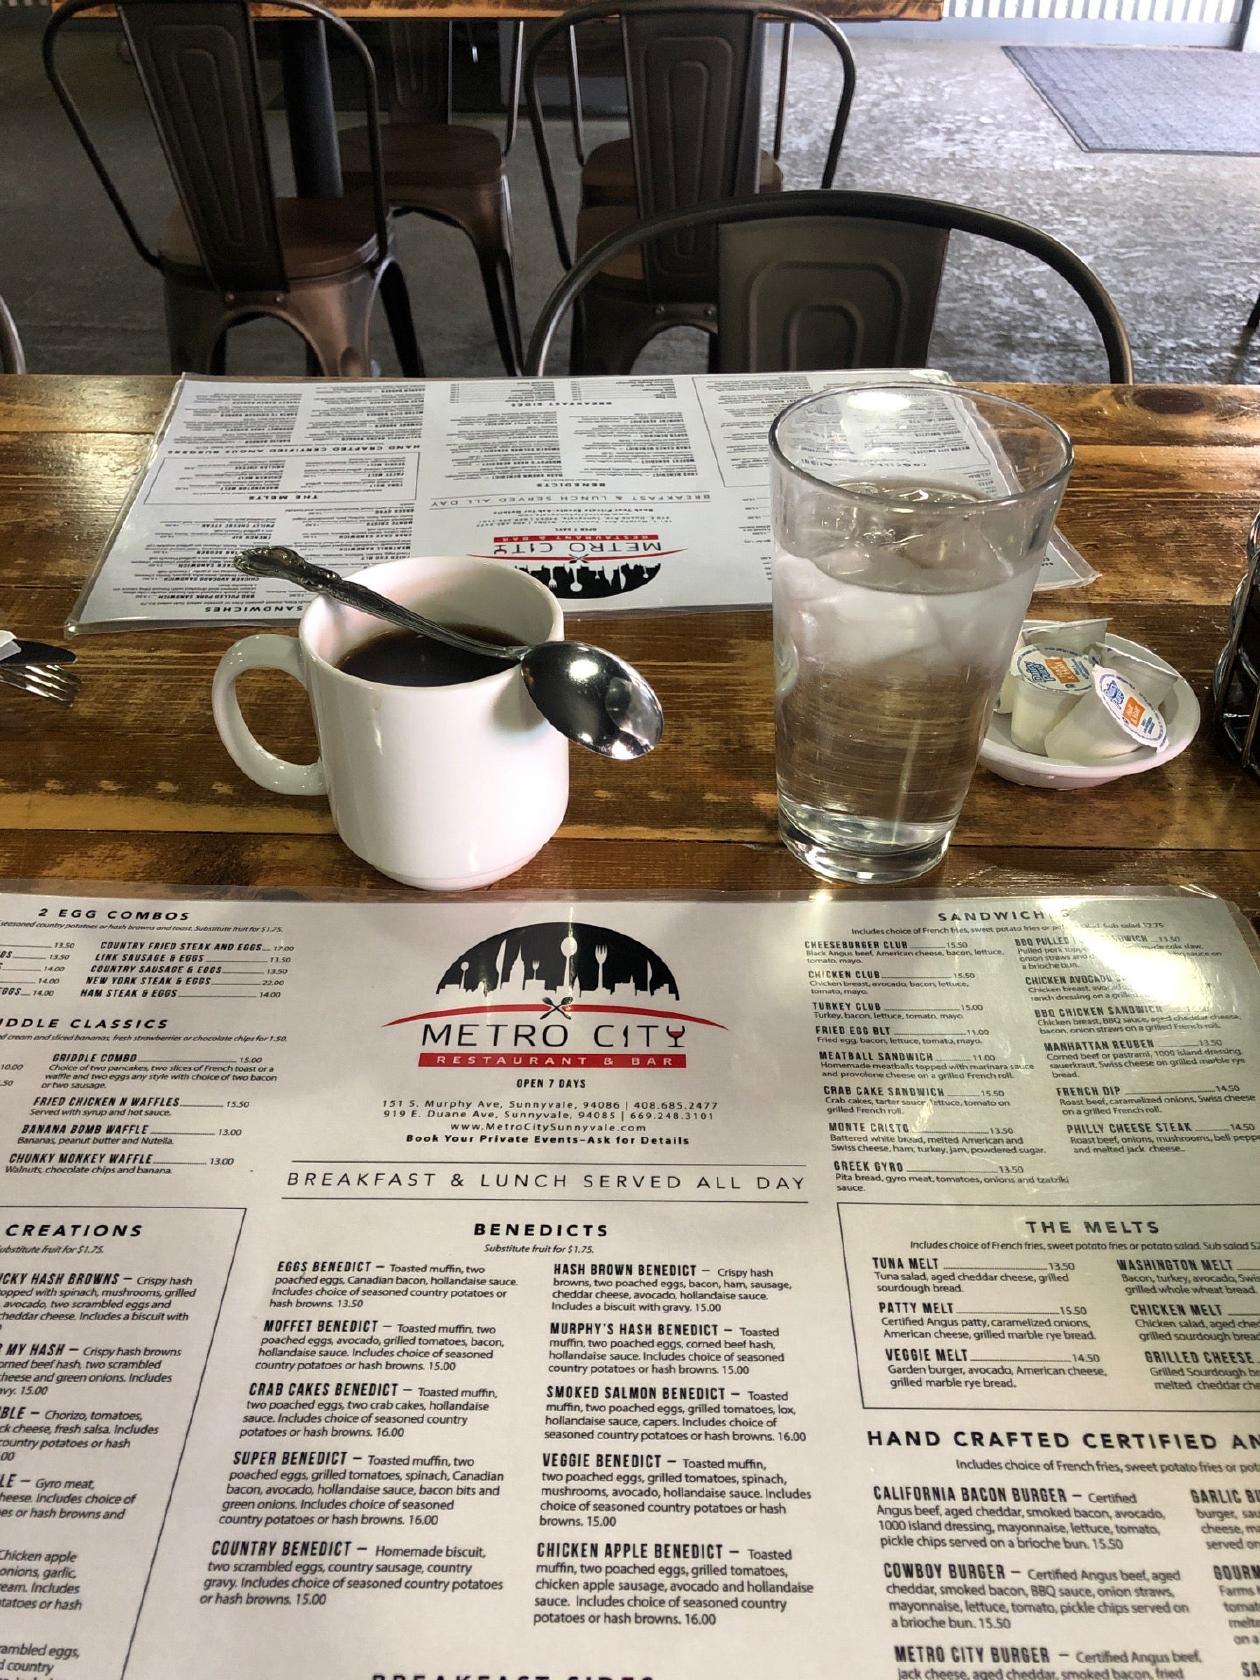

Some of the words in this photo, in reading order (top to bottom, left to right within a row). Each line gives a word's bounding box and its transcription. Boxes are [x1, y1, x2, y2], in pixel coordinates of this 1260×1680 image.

[494, 543, 552, 554] CITY
[570, 542, 661, 552] METRO
[39, 908, 48, 916] 2
[59, 909, 96, 918] EGG
[108, 911, 188, 920] COMBOS
[805, 941, 879, 949] CHEESEBURGER
[81, 989, 102, 997] HAM
[813, 1002, 850, 1010] TURKEY
[856, 1003, 880, 1011] CLUB
[71, 1019, 167, 1028] CLASSICS
[422, 1024, 568, 1047] METRO
[594, 1025, 685, 1047] CITY
[816, 1026, 845, 1034] FRIED
[850, 1026, 868, 1035] EGG
[873, 1027, 889, 1035] BLT
[1044, 1041, 1109, 1051] MANHATTAN
[1112, 1040, 1154, 1049] REUBEN
[53, 1054, 96, 1062] GRIDDLE
[101, 1054, 137, 1062] COMBO
[437, 1056, 586, 1064] RESTAURANT
[517, 1079, 543, 1087] OPEN
[549, 1079, 554, 1088] 7
[559, 1079, 585, 1088] DAYS
[1056, 1087, 1099, 1096] FRENCH
[1103, 1086, 1120, 1095] DIP
[33, 1097, 65, 1106] FRIED
[69, 1097, 116, 1106] CHICKEN
[119, 1098, 127, 1106] N
[131, 1097, 180, 1106] WAFFLES
[425, 1100, 472, 1109] Murphy
[509, 1101, 577, 1110] Sunnyvale,
[505, 1111, 571, 1120] Sunnyvale,
[631, 1112, 712, 1120] 669.248.3101
[22, 1125, 66, 1133] BANANA
[70, 1125, 101, 1134] BOMB
[106, 1125, 148, 1134] WAFFLE
[451, 1123, 646, 1132] www.MetroCitySunnyvale.com
[480, 1135, 528, 1143] Private
[616, 1136, 634, 1144] for
[10, 1153, 55, 1163] CHUNKY
[59, 1154, 105, 1163] MONKEY
[109, 1154, 152, 1164] WAFFLE
[834, 1161, 869, 1171] GREEK
[874, 1162, 903, 1172] GYRO
[288, 1173, 435, 1186] BREAKFAST
[451, 1174, 463, 1186] &
[481, 1174, 565, 1187] LUNCH
[584, 1175, 680, 1188] SERVED
[697, 1177, 740, 1189] ALL
[757, 1177, 803, 1189] DAY
[6, 1224, 141, 1236] CREATIONS
[474, 1224, 606, 1236] BENEDICTS
[1026, 1222, 1071, 1233] THE
[1084, 1222, 1158, 1233] MELTS
[484, 1244, 530, 1252] Substitute
[553, 1245, 566, 1253] for
[568, 1245, 593, 1253] $1.75.
[277, 1261, 307, 1271] EGGS
[312, 1262, 371, 1271] BENEDICT
[872, 1257, 904, 1269] TUNA
[909, 1258, 937, 1269] MELT
[1117, 1260, 1198, 1270] WASHINGTON
[1201, 1260, 1232, 1270] MELT
[554, 1264, 585, 1275] HASH
[591, 1264, 632, 1275] BROWN
[639, 1265, 696, 1276] BENEDICT
[264, 1320, 312, 1332] MOFFET
[318, 1320, 378, 1332] BENEDICT
[620, 1324, 651, 1335] HASH
[658, 1324, 717, 1336] BENEDICT
[249, 1383, 283, 1395] CRAB
[289, 1383, 329, 1396] CAKES
[335, 1383, 398, 1396] BENEDICT
[868, 1431, 940, 1446] HAND
[954, 1432, 1069, 1447] CRAFTED
[1083, 1433, 1216, 1449] CERTIFIED
[233, 1452, 276, 1465] SUPER
[282, 1452, 347, 1465] BENEDICT
[874, 1486, 955, 1501] CALIFORNIA
[961, 1487, 1006, 1501] BACON
[1012, 1488, 1067, 1502] BURGER
[537, 1543, 598, 1557] CHICKEN
[605, 1543, 647, 1558] APPLE
[655, 1544, 722, 1559] BENEDICT
[884, 1563, 941, 1578] COWBOY
[949, 1564, 1005, 1579] BURGER
[894, 1646, 945, 1662] METRO
[951, 1647, 983, 1662] CITY
[991, 1647, 1049, 1663] BURGER
